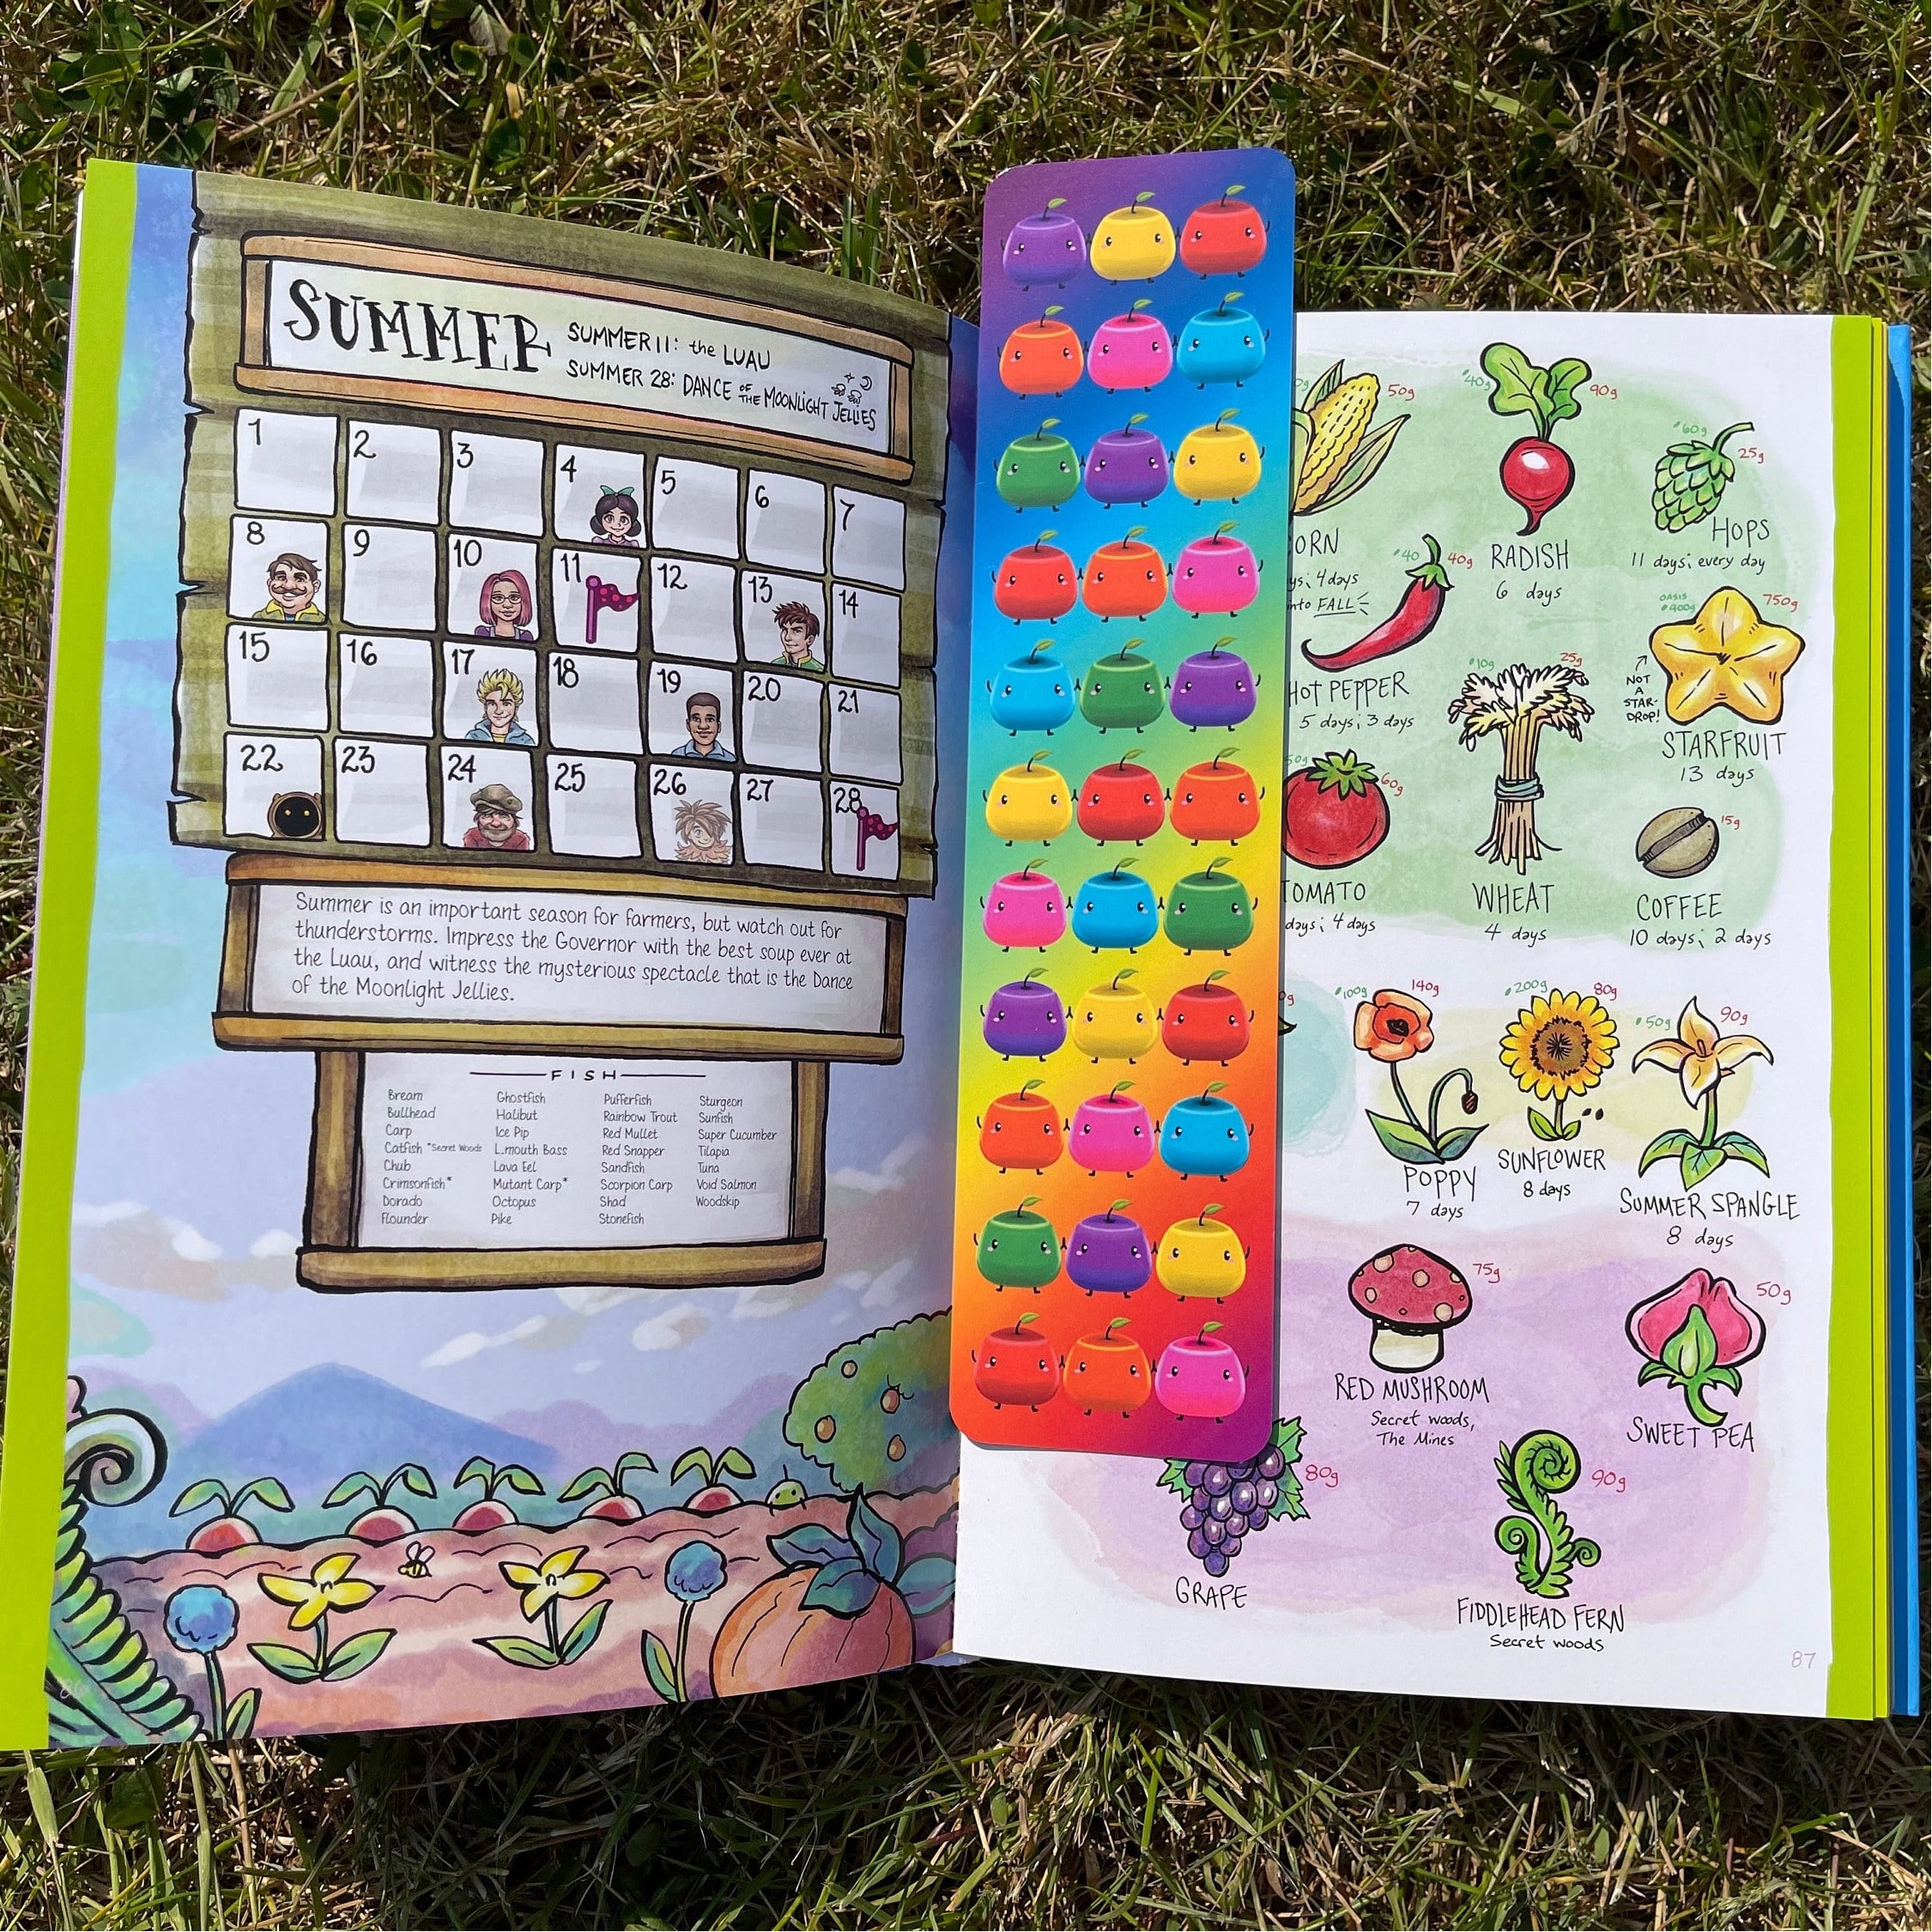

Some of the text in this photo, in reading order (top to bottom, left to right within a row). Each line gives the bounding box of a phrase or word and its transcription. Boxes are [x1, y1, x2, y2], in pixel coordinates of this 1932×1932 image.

[284, 278, 552, 372] SUMMER
[567, 322, 651, 350] SUMMER
[689, 340, 716, 358] the
[724, 345, 770, 370] LUAU
[566, 360, 644, 387] SUMMER
[651, 369, 675, 388] 28:
[683, 375, 731, 400] DANCE
[738, 394, 760, 405] THE
[1388, 385, 1415, 400] 50g
[1590, 385, 1617, 400] 90g
[1289, 528, 1338, 555] ORN
[1712, 517, 1770, 548] HOPS
[454, 539, 482, 567] 10
[1448, 553, 1473, 569] 40g
[1492, 540, 1569, 571] RADISH
[560, 553, 581, 583] 11
[657, 563, 687, 590] 12
[748, 576, 772, 603] 13
[839, 589, 858, 619] 14
[1317, 597, 1353, 611] FALL
[1763, 594, 1798, 611] 750g
[239, 631, 270, 662] 15
[346, 639, 378, 666] 16
[451, 648, 475, 675] 17
[553, 656, 578, 687] 18
[657, 669, 681, 693] 19
[748, 675, 780, 701] 20
[1626, 674, 1650, 685] NOT
[1330, 671, 1409, 711] PEPPER
[1635, 687, 1644, 695] A
[838, 690, 859, 713] 21
[1623, 698, 1657, 707] STAR-
[1627, 710, 1660, 723] DROP!
[1662, 730, 1786, 760] STARFRUIT
[239, 744, 283, 772] 22
[341, 746, 375, 773] 23
[448, 754, 476, 784] 24
[554, 762, 585, 792] 25
[653, 769, 686, 796] 26
[747, 778, 773, 802] 27
[1281, 880, 1366, 905] TOMATO
[1473, 882, 1554, 914] WHEAT
[296, 891, 842, 939] Summer is an important season for farmers, but watch out for
[1637, 893, 1723, 921] COFFEE
[295, 919, 851, 966] thunderstorms. Impress the Governor with the best soup ever at
[294, 948, 854, 990] the Luau, and witness the mysterious spectacle that is the Dance
[292, 974, 514, 1008] of the Moonlight Jellies.
[1412, 979, 1439, 996] 140g
[1514, 979, 1547, 994] 200g
[1594, 983, 1617, 1001] 80g
[1721, 1007, 1747, 1025] 90g
[388, 1088, 423, 1100] Bream
[497, 1091, 545, 1104] Ghostfish
[604, 1093, 651, 1105] Pufferfish
[700, 1095, 742, 1111] Sturgeon
[387, 1106, 436, 1119] Bullhead
[496, 1109, 538, 1121] Halibut
[603, 1110, 677, 1123] Rainbow Trout
[699, 1111, 733, 1123] Sunfish
[385, 1123, 412, 1139] Carp
[698, 1129, 777, 1142] Super Cucumber
[385, 1142, 422, 1154] Catfish
[494, 1143, 567, 1156] L.mouth Bass
[602, 1145, 665, 1159] Red Snapper
[698, 1145, 730, 1160] Tilapia
[384, 1160, 411, 1171] Chub
[494, 1160, 536, 1172] Lava Eel
[602, 1161, 645, 1173] Sandfish
[698, 1162, 719, 1173] Tuna
[1498, 1147, 1606, 1173] SUNFLOWER
[494, 1178, 532, 1190] Mutant
[601, 1178, 673, 1193] Scorpion Carp
[697, 1178, 756, 1190] Void Salmon
[1404, 1165, 1476, 1202] POPPY
[383, 1195, 422, 1207] Dorado
[493, 1196, 536, 1210] Octopus
[600, 1196, 627, 1207] Shad
[696, 1196, 740, 1209] Woodskip
[1620, 1187, 1800, 1220] SUMMER SPANGLE
[381, 1213, 428, 1225] Flounder
[491, 1214, 512, 1225] Pike
[599, 1214, 644, 1225] Stonefish
[1473, 1263, 1500, 1283] 75g
[1756, 1281, 1791, 1305] 50g
[1335, 1373, 1489, 1403] RED MUSHROOM
[1371, 1409, 1475, 1432] Secret woods,
[1377, 1432, 1454, 1445] The Mines
[1626, 1416, 1754, 1452] SWEET PEA
[1305, 1464, 1338, 1487] 80g
[1592, 1469, 1626, 1493] 90g
[1176, 1577, 1247, 1610] GRAPE
[1457, 1598, 1625, 1632] FIDDLEHEAD FERN
[1490, 1635, 1604, 1652] Secret woods
[1791, 1651, 1816, 1669] 87
